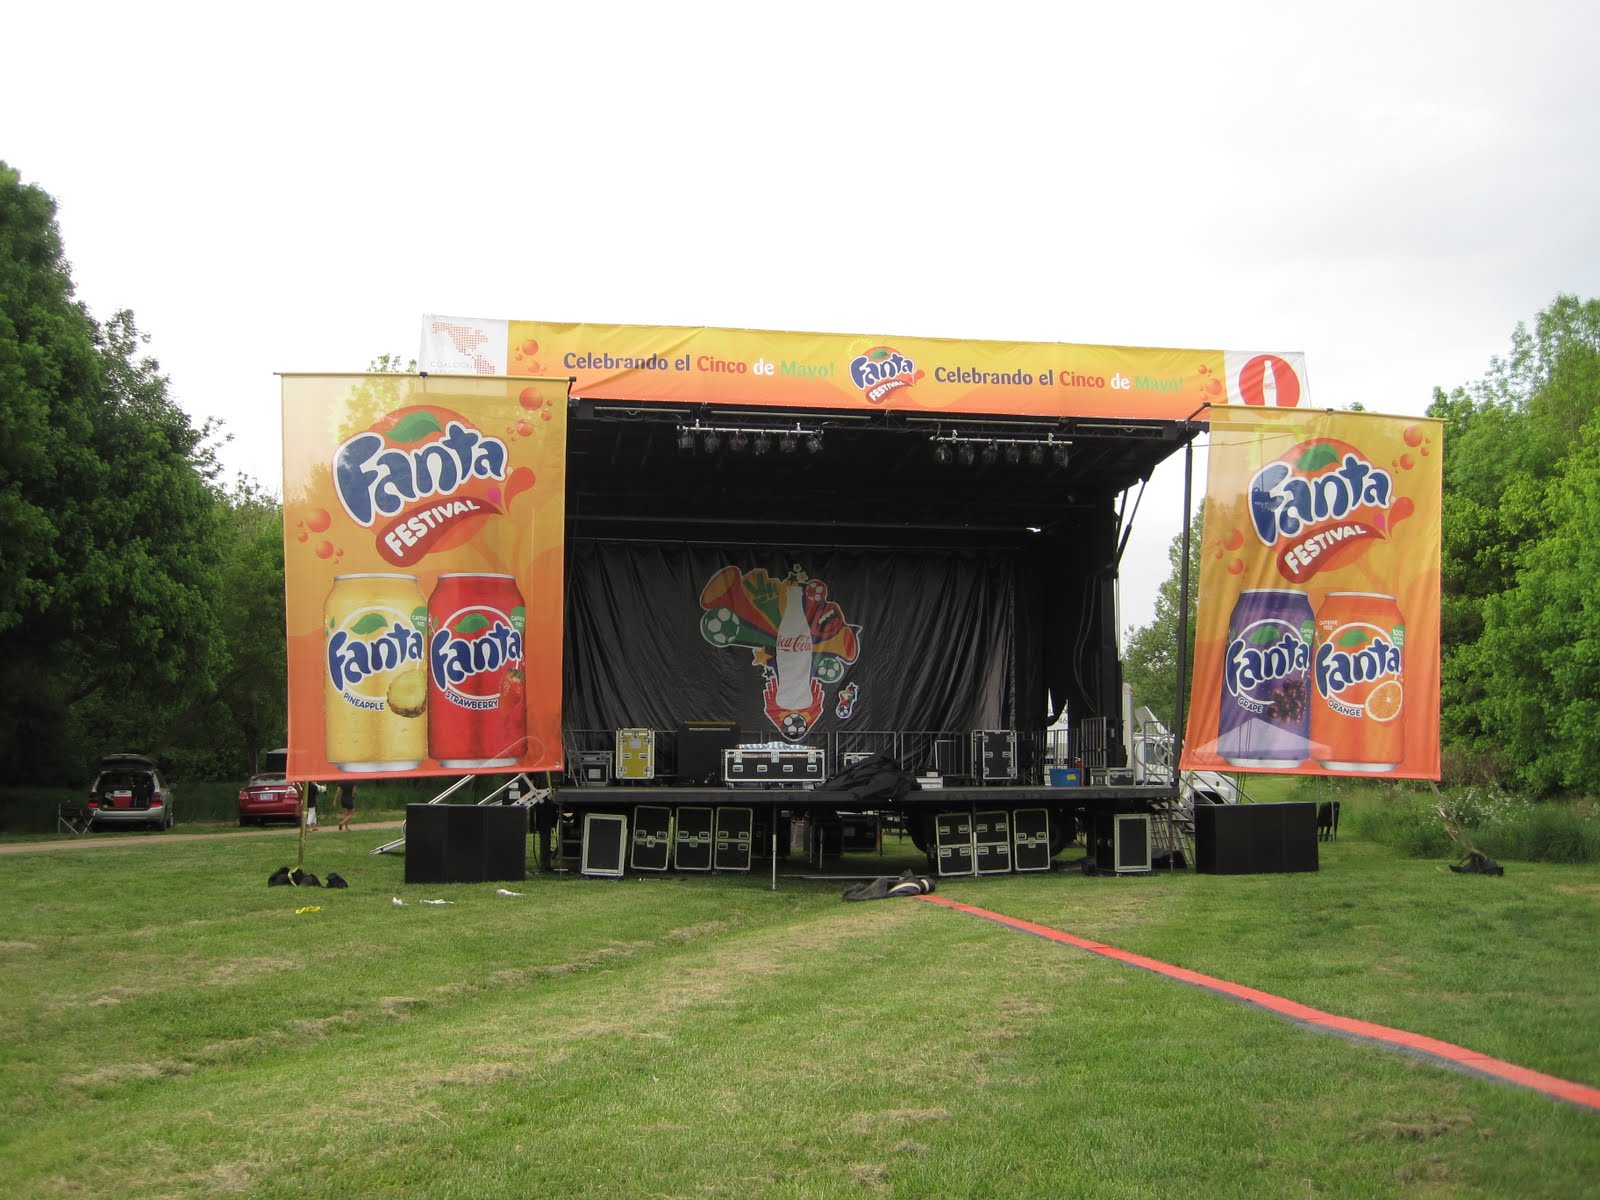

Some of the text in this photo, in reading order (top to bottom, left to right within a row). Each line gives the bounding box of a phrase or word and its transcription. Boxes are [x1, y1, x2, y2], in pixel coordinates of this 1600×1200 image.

[563, 352, 835, 382] Celebrando el Cinco de Mayo!
[849, 352, 914, 390] Fanta
[934, 366, 1185, 395] Celebrando el Cinco de Mayo!
[868, 380, 906, 401] FESTIVAL
[333, 420, 507, 528] Fanta
[1248, 453, 1392, 546] Fanta
[384, 499, 480, 557] FESTIVAL
[1284, 525, 1367, 575] FESTIVAL
[327, 622, 424, 691] Fanta
[431, 620, 523, 691] Fanta
[1226, 632, 1310, 696] Fanta
[1315, 636, 1401, 698] Fanta
[343, 691, 385, 711] PINEAPPLE
[445, 689, 498, 711] STRAWBERRY
[1237, 696, 1263, 714] GRAPE
[1328, 699, 1361, 717] ORANGE
